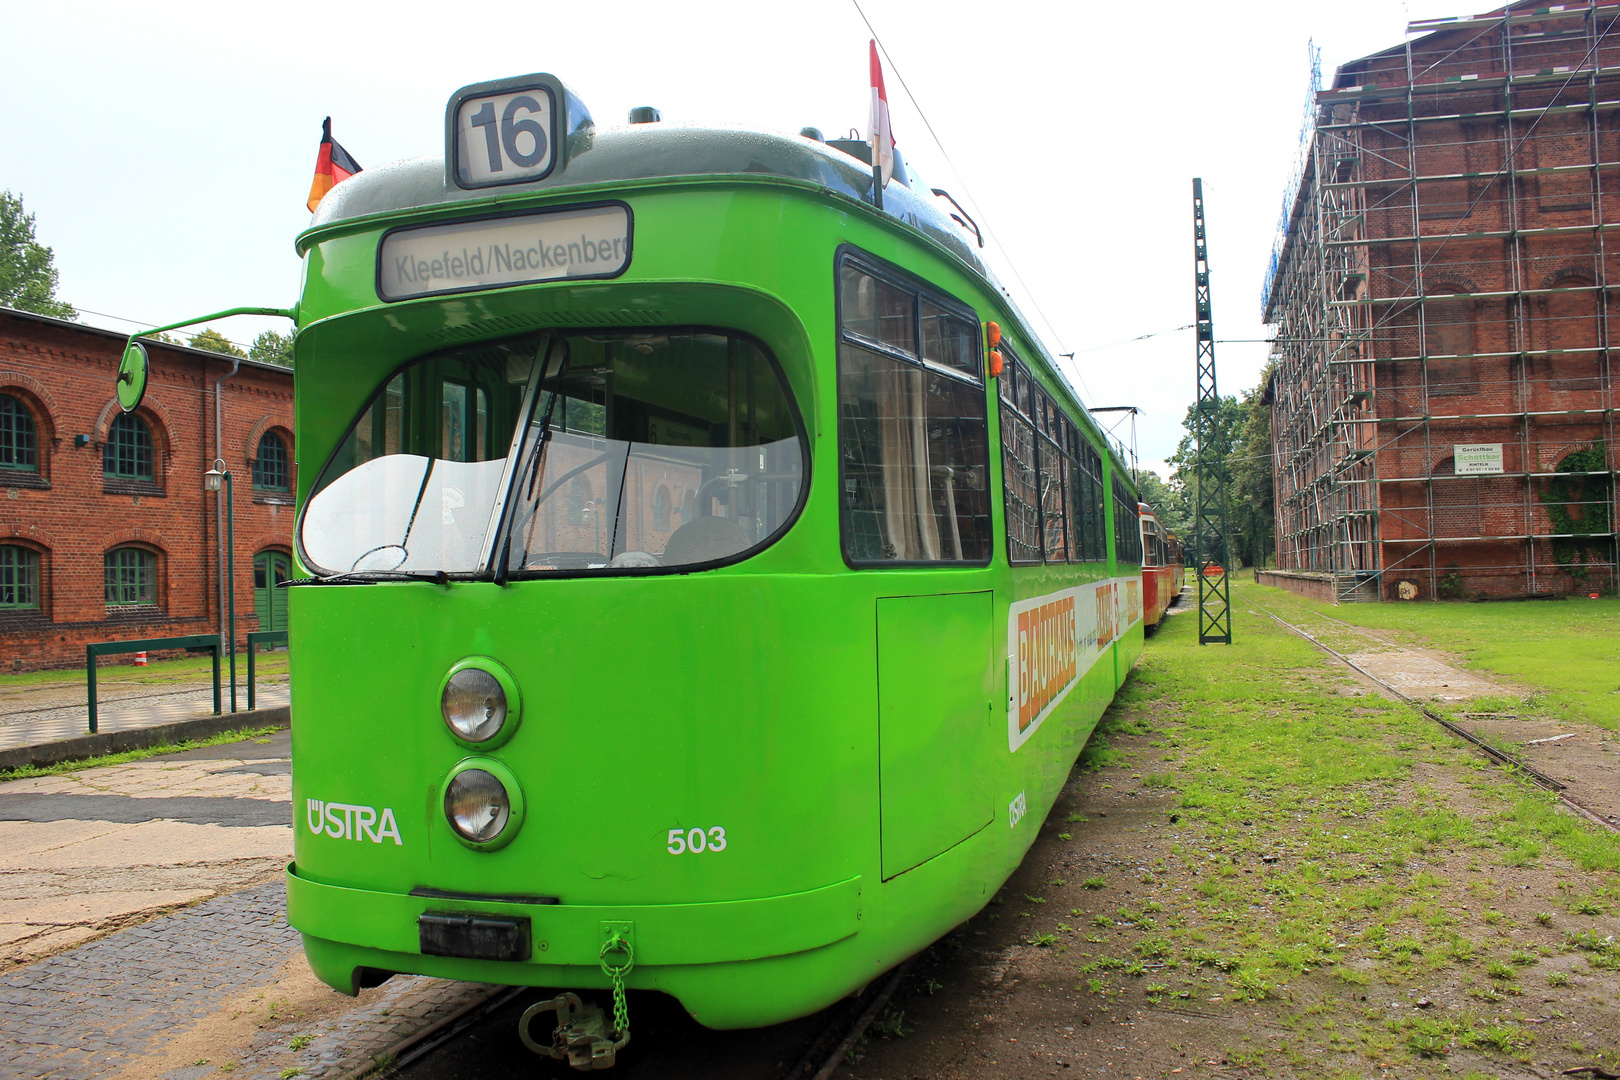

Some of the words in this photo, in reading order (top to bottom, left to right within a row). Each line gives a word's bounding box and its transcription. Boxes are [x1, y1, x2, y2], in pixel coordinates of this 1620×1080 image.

[470, 95, 548, 173] 16
[1019, 606, 1075, 709] BAUHAUS
[666, 826, 728, 855] 503
